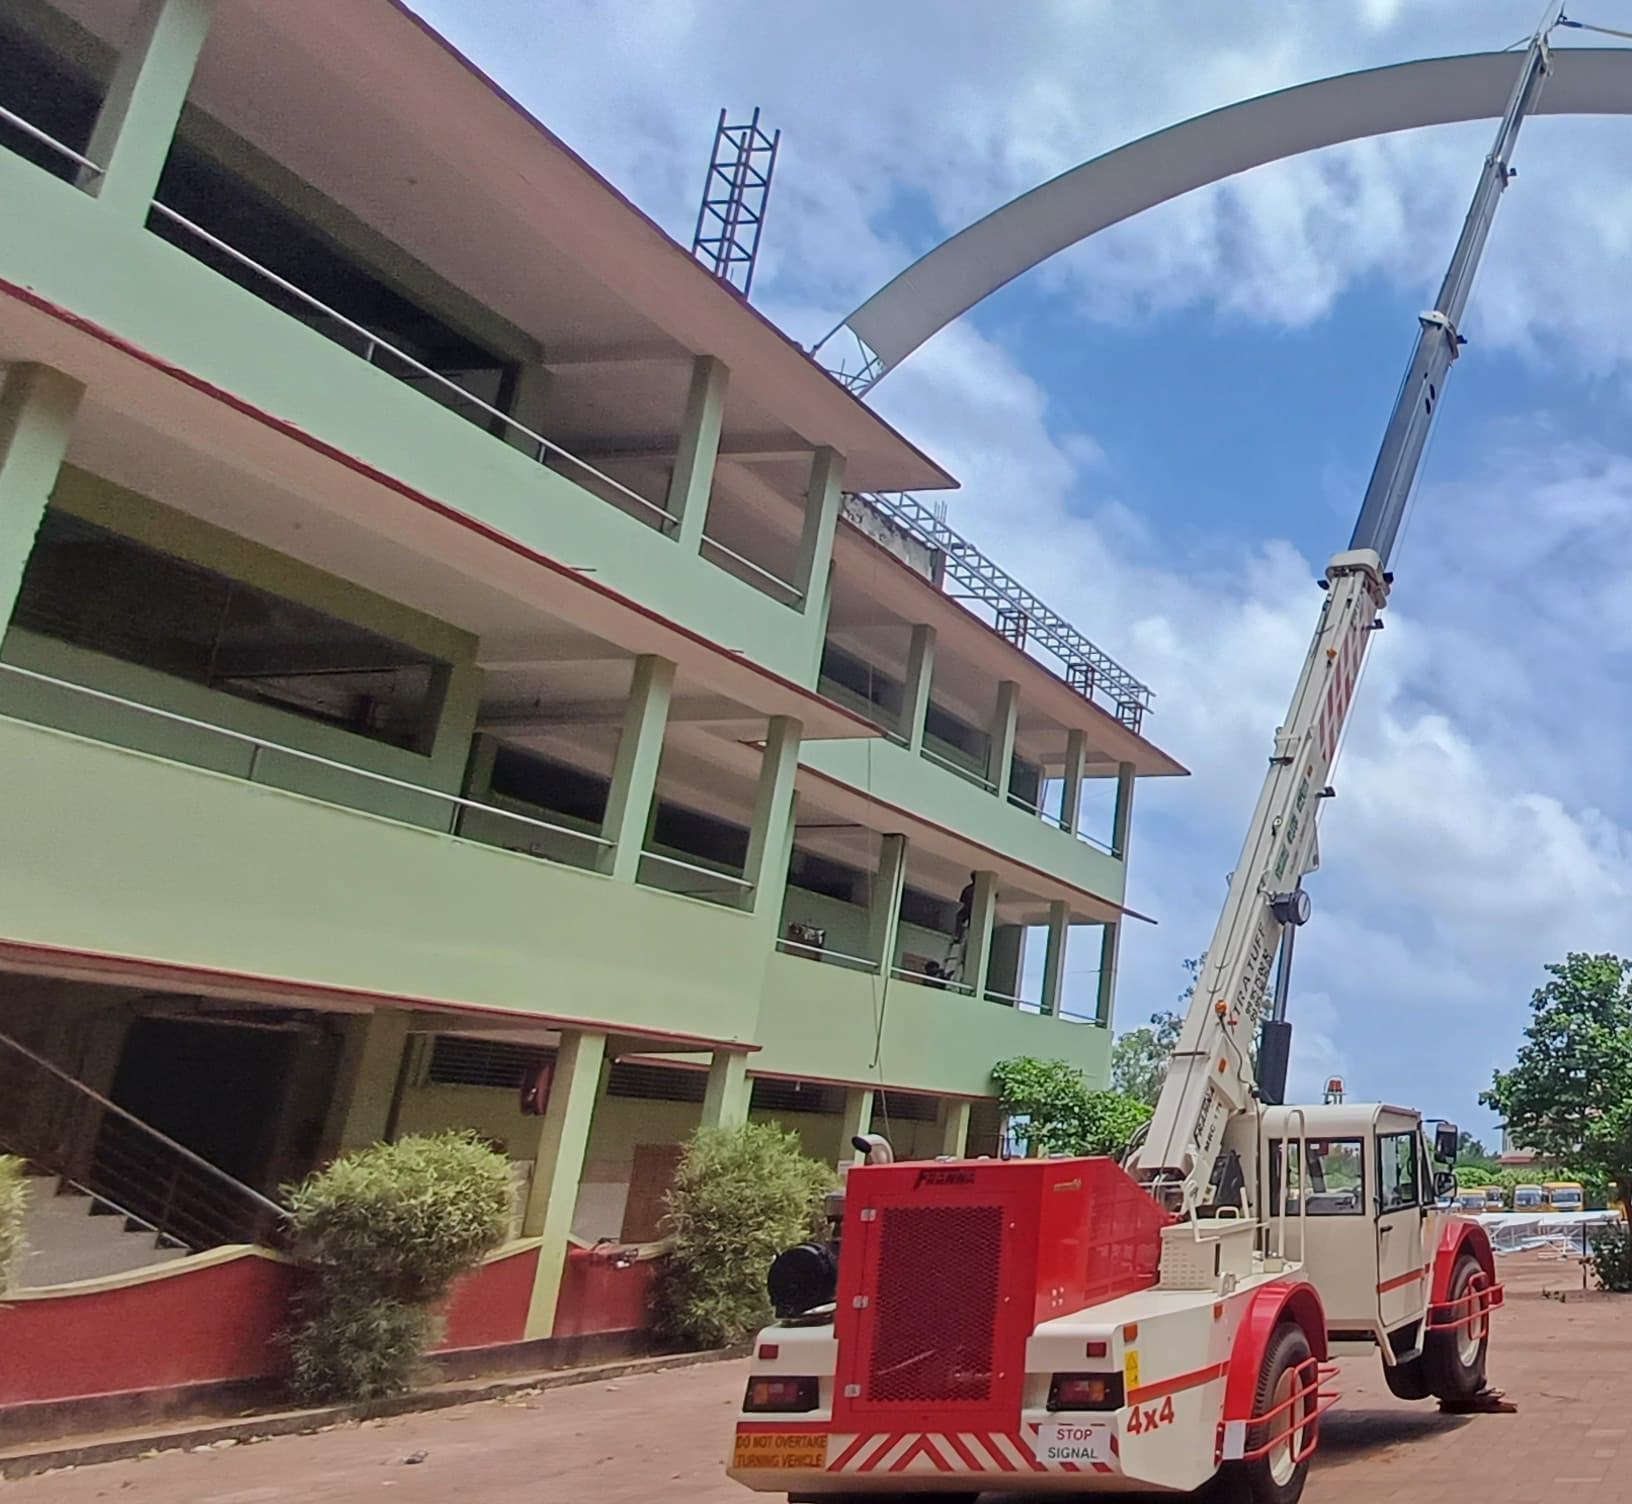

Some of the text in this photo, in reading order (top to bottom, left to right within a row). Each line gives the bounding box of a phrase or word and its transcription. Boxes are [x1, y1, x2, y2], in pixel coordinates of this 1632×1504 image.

[1127, 1396, 1175, 1435] 4x4
[736, 1434, 828, 1449] DO NOT OVERTAKE
[1056, 1428, 1093, 1441] STOP
[782, 1453, 824, 1468] VEHICLE
[1047, 1446, 1098, 1460] SIGNAL
